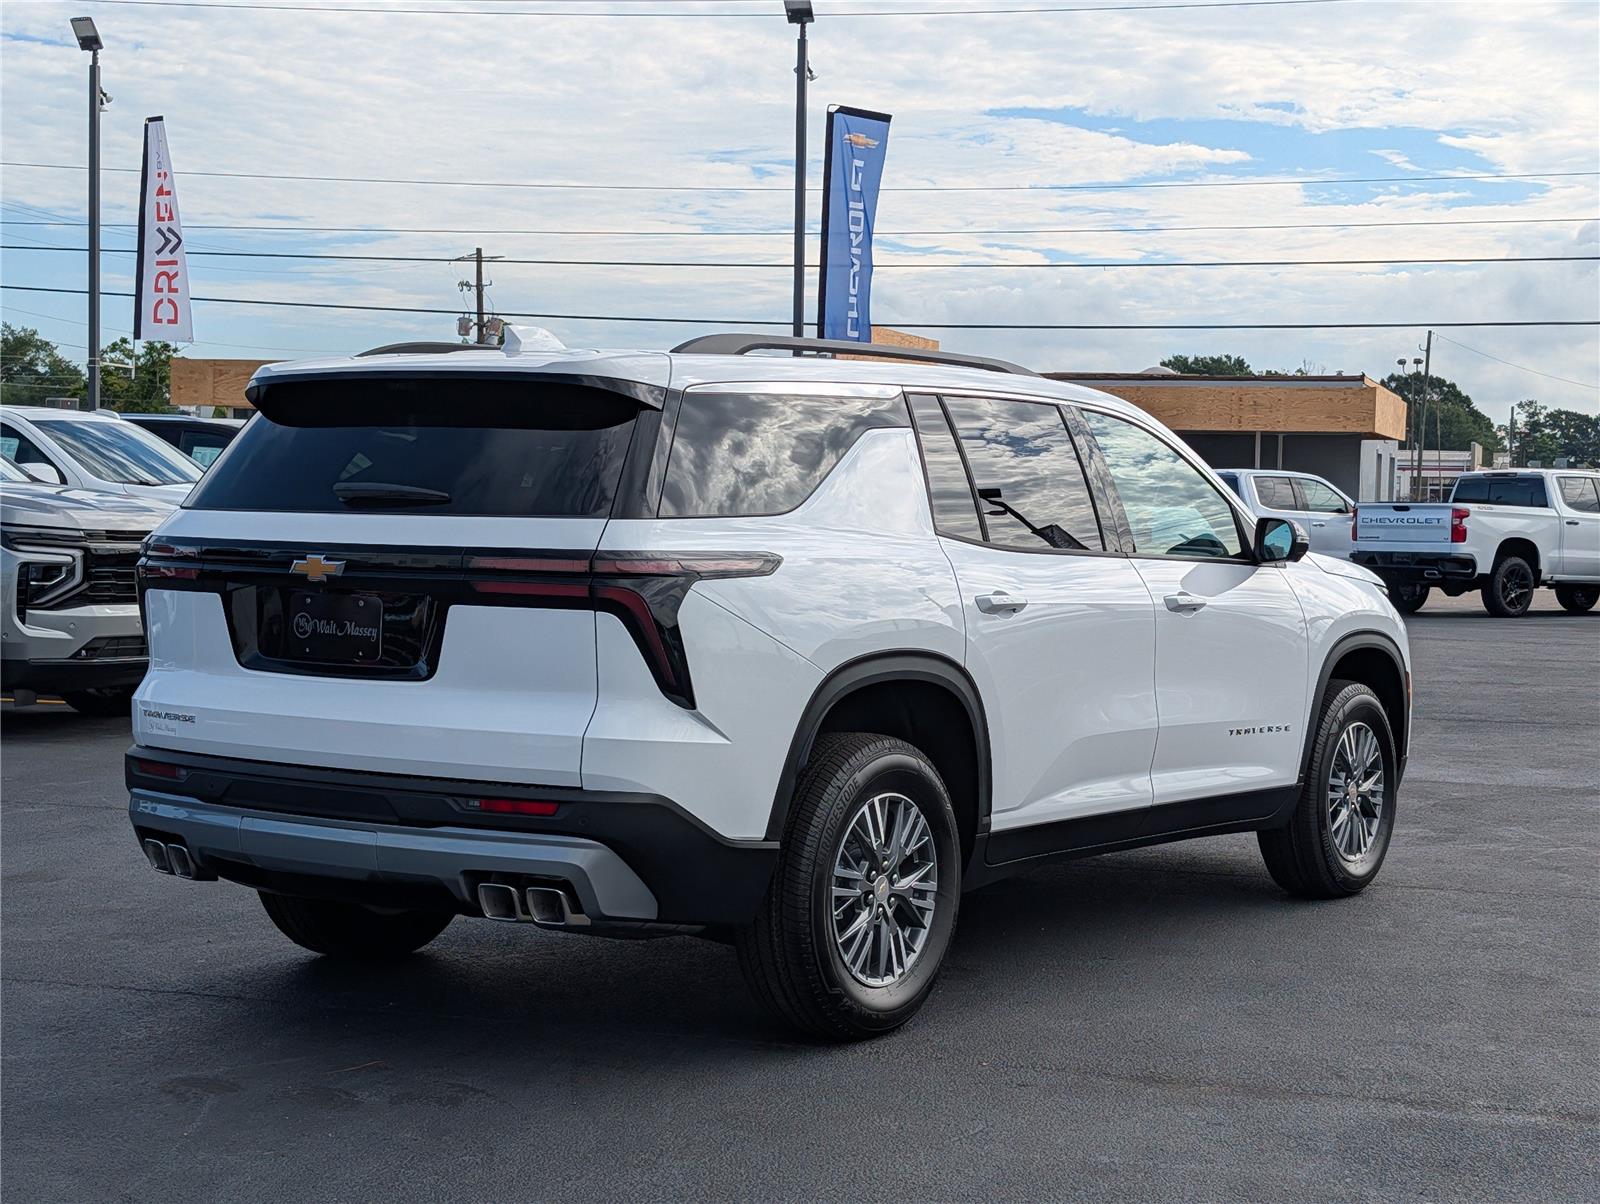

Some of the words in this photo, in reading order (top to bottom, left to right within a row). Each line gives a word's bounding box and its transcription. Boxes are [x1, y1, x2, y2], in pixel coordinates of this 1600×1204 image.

[1361, 517, 1444, 525] CHEVROLET
[337, 620, 377, 641] Massey
[1228, 724, 1291, 737] TRAVERSE
